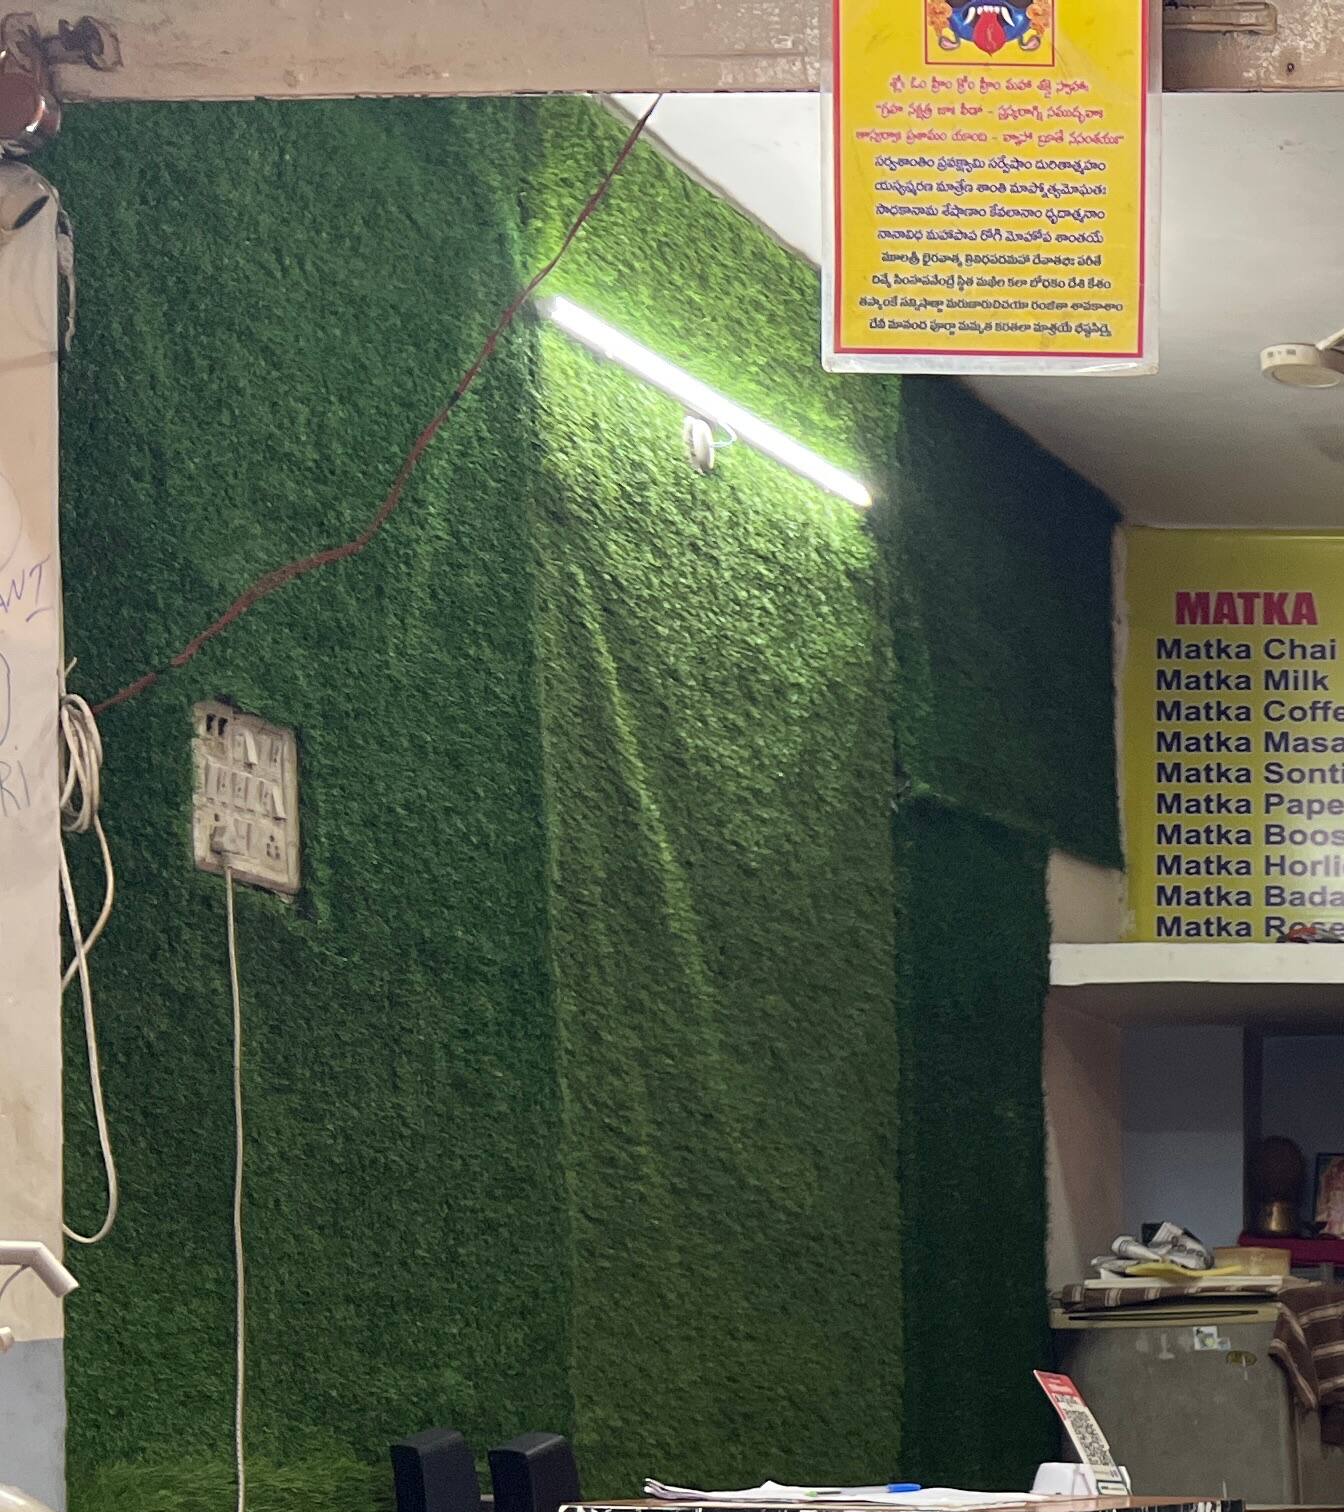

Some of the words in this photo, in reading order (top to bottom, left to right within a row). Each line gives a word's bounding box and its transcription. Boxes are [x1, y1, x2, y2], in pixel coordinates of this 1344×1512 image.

[1175, 592, 1318, 625] MATKA
[1156, 639, 1252, 660] Matka
[1264, 638, 1336, 661] Chai
[1156, 670, 1252, 692] Matka
[1264, 669, 1330, 692] Milk
[1156, 701, 1252, 723] Matka
[1156, 732, 1252, 753] Matka
[1156, 763, 1252, 784] Matka
[1156, 794, 1252, 815] Matka
[1156, 825, 1252, 846] Matka
[1156, 855, 1252, 877] Matka
[1156, 886, 1252, 907] Matka
[1156, 916, 1252, 938] Matka
